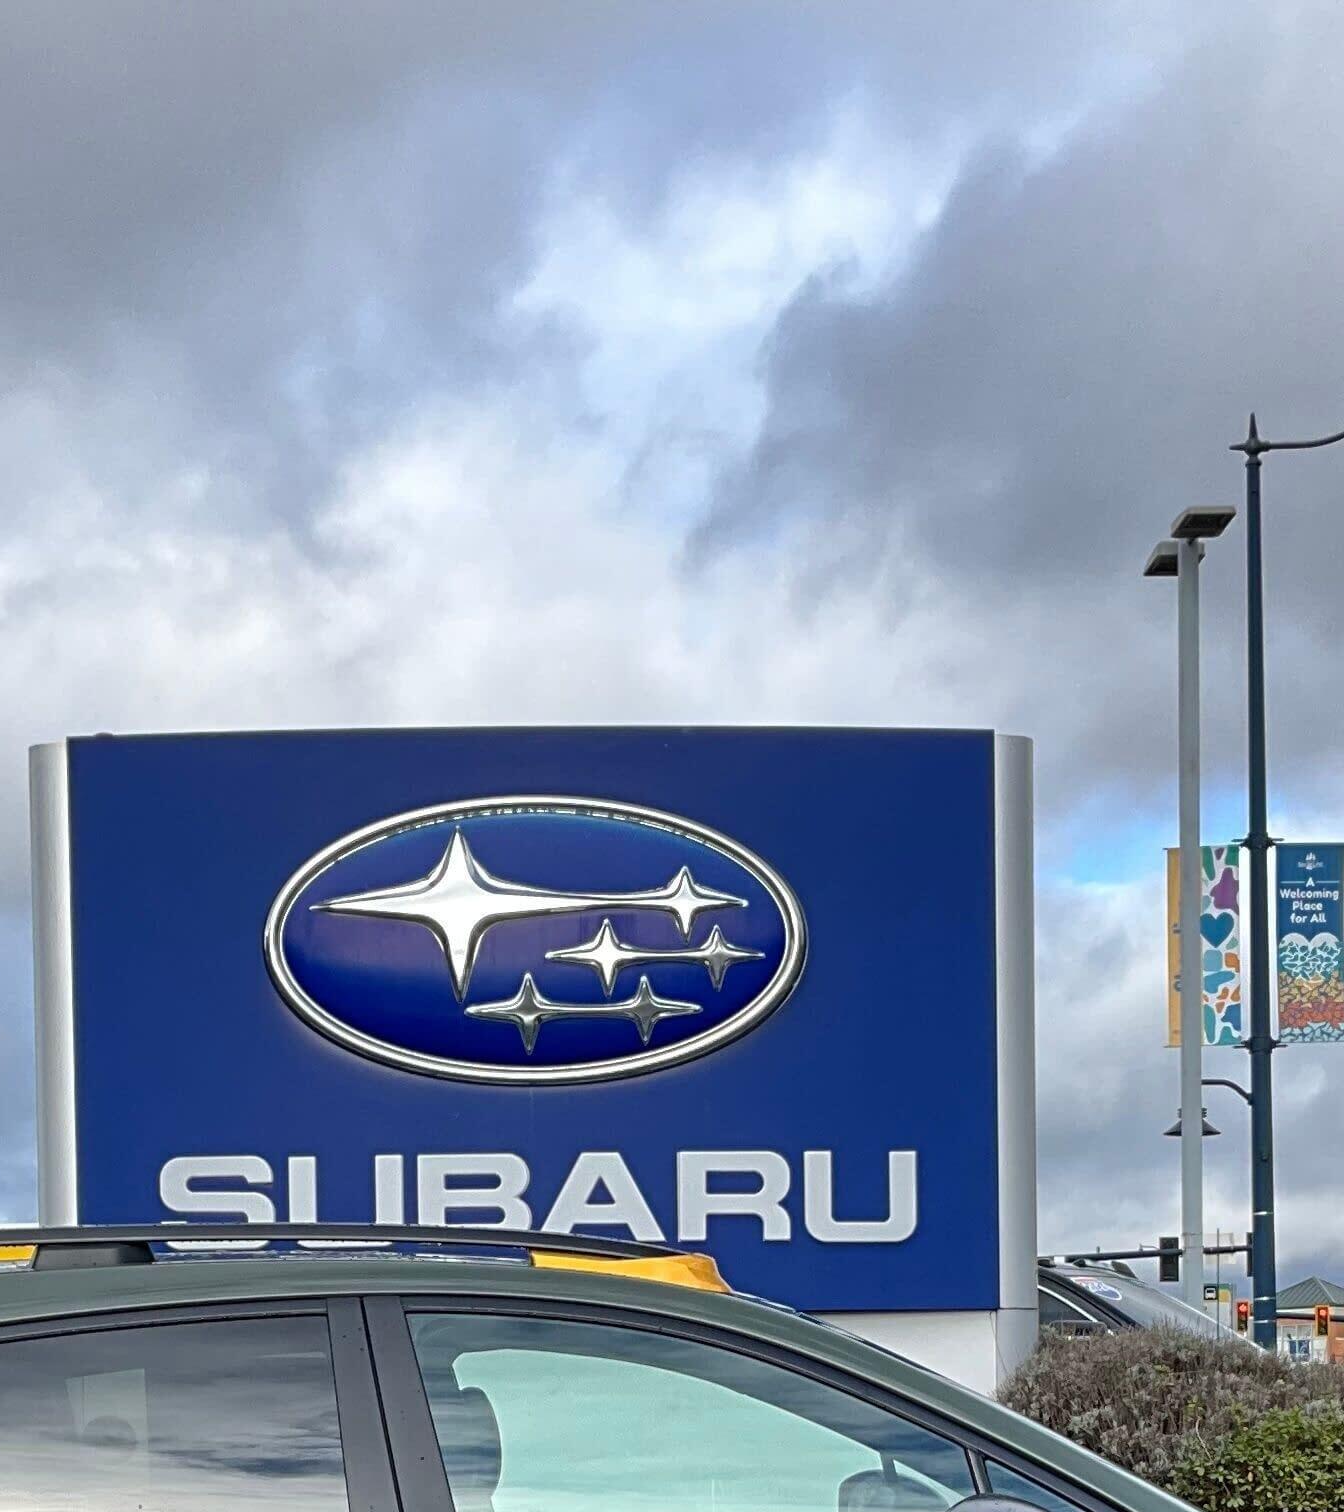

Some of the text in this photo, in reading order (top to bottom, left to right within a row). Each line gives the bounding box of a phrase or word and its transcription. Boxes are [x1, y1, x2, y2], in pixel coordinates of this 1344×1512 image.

[1305, 877, 1315, 887] A
[1279, 888, 1339, 901] Welcoming
[1292, 900, 1323, 911] Place
[1290, 912, 1327, 923] for All
[159, 1150, 918, 1248] SUBARU
